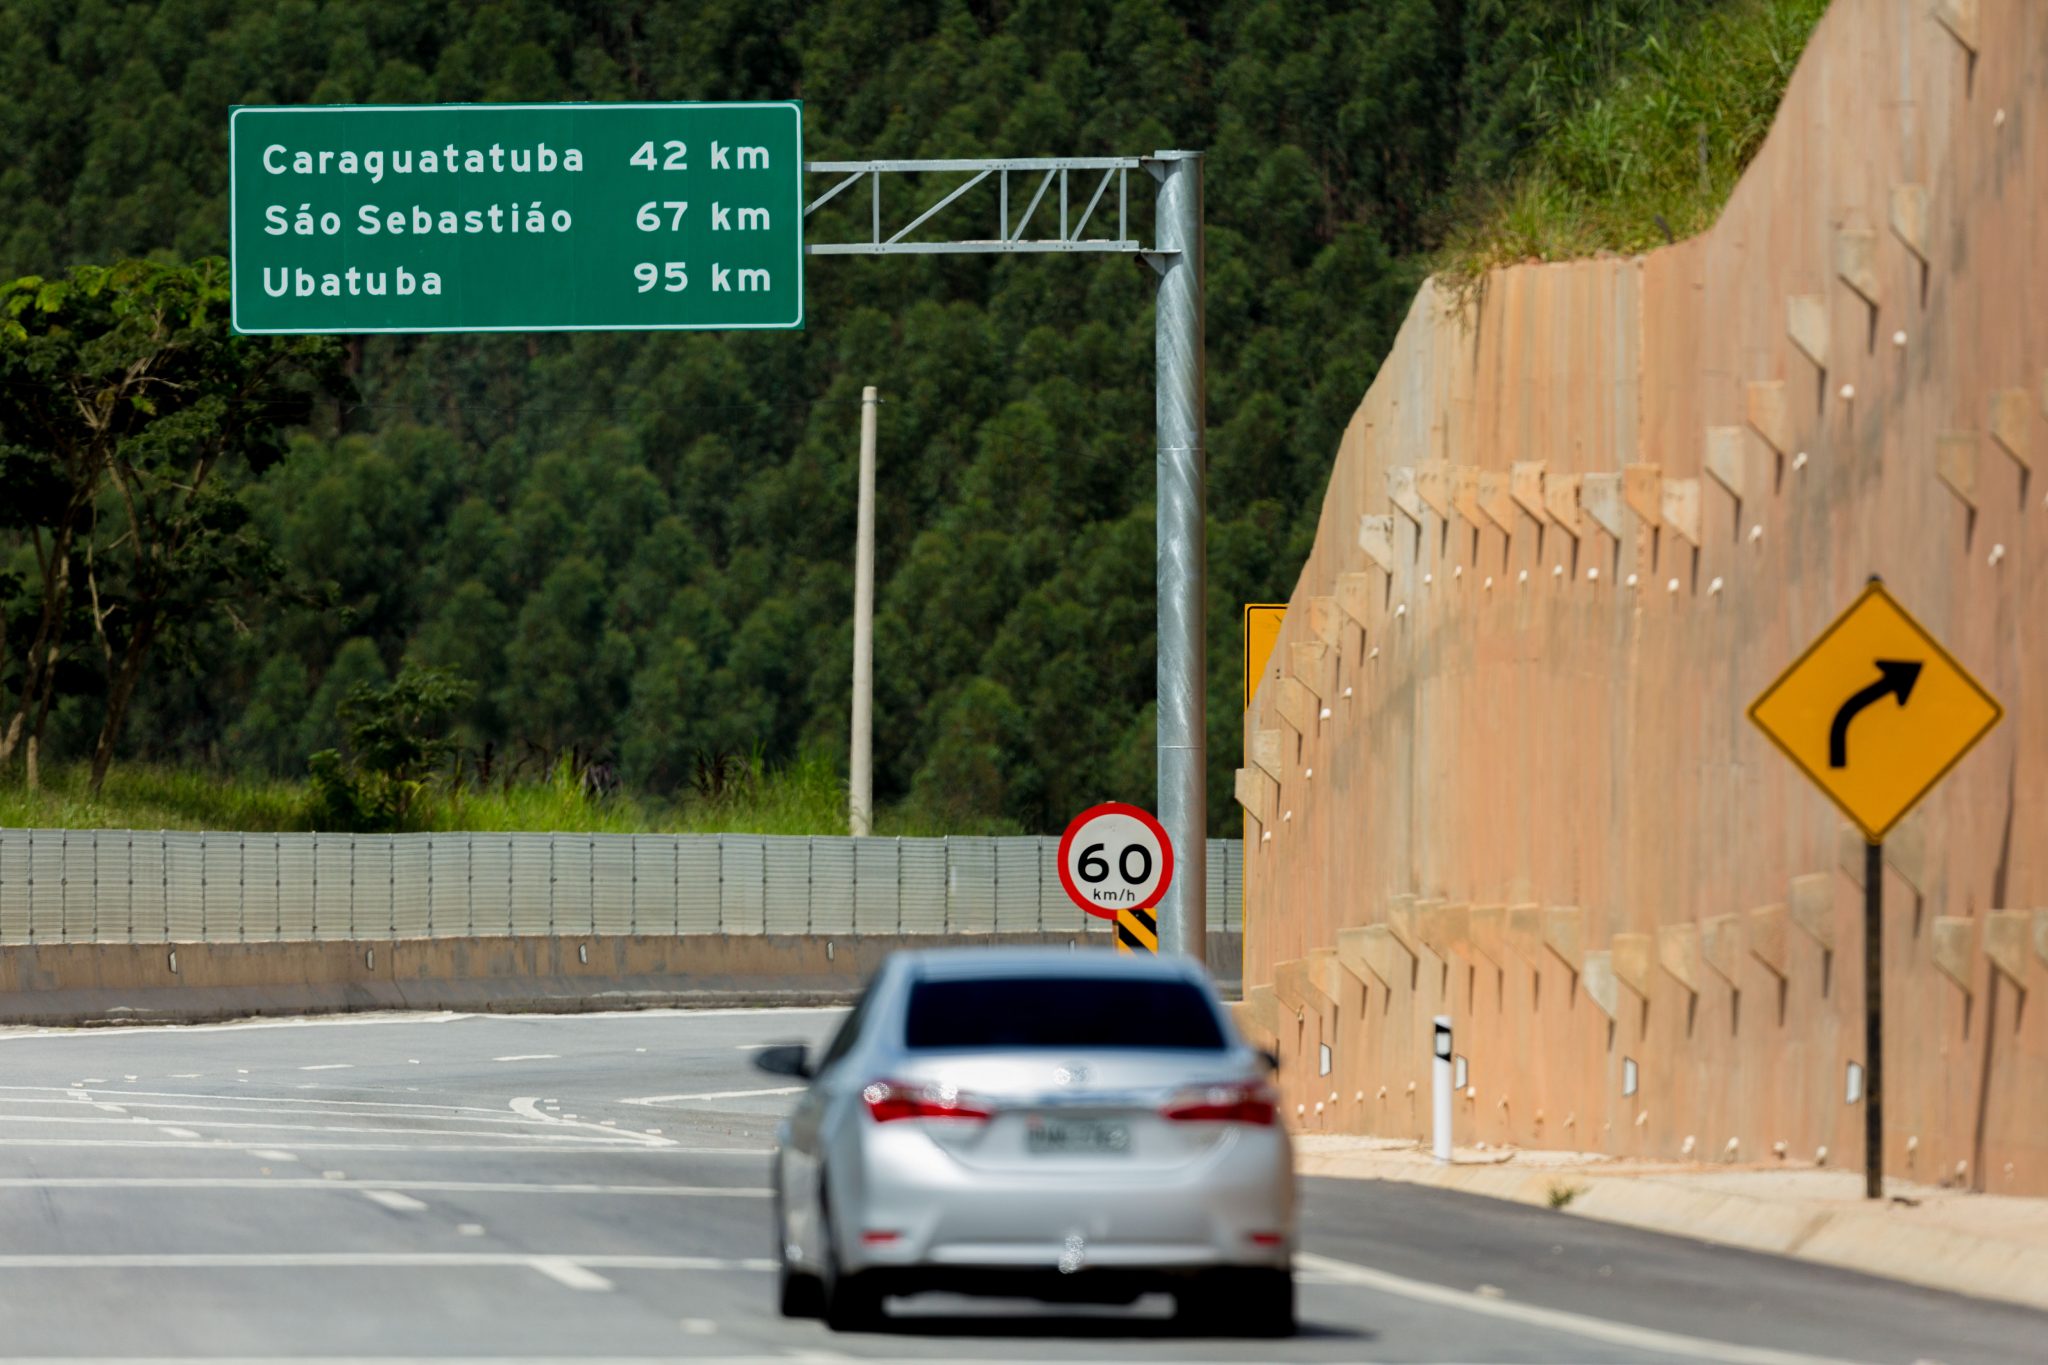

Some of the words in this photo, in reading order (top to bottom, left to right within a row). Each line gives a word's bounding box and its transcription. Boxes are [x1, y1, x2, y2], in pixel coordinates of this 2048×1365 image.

[263, 142, 583, 184] Caraguatatuba
[629, 140, 688, 171] 42
[711, 140, 769, 170] km
[636, 201, 688, 232] 67
[711, 201, 770, 231] km
[263, 266, 442, 297] Ubatuba
[633, 261, 688, 293] 95
[712, 262, 771, 292] km
[1077, 843, 1153, 885] 60
[1093, 888, 1136, 902] km/h
